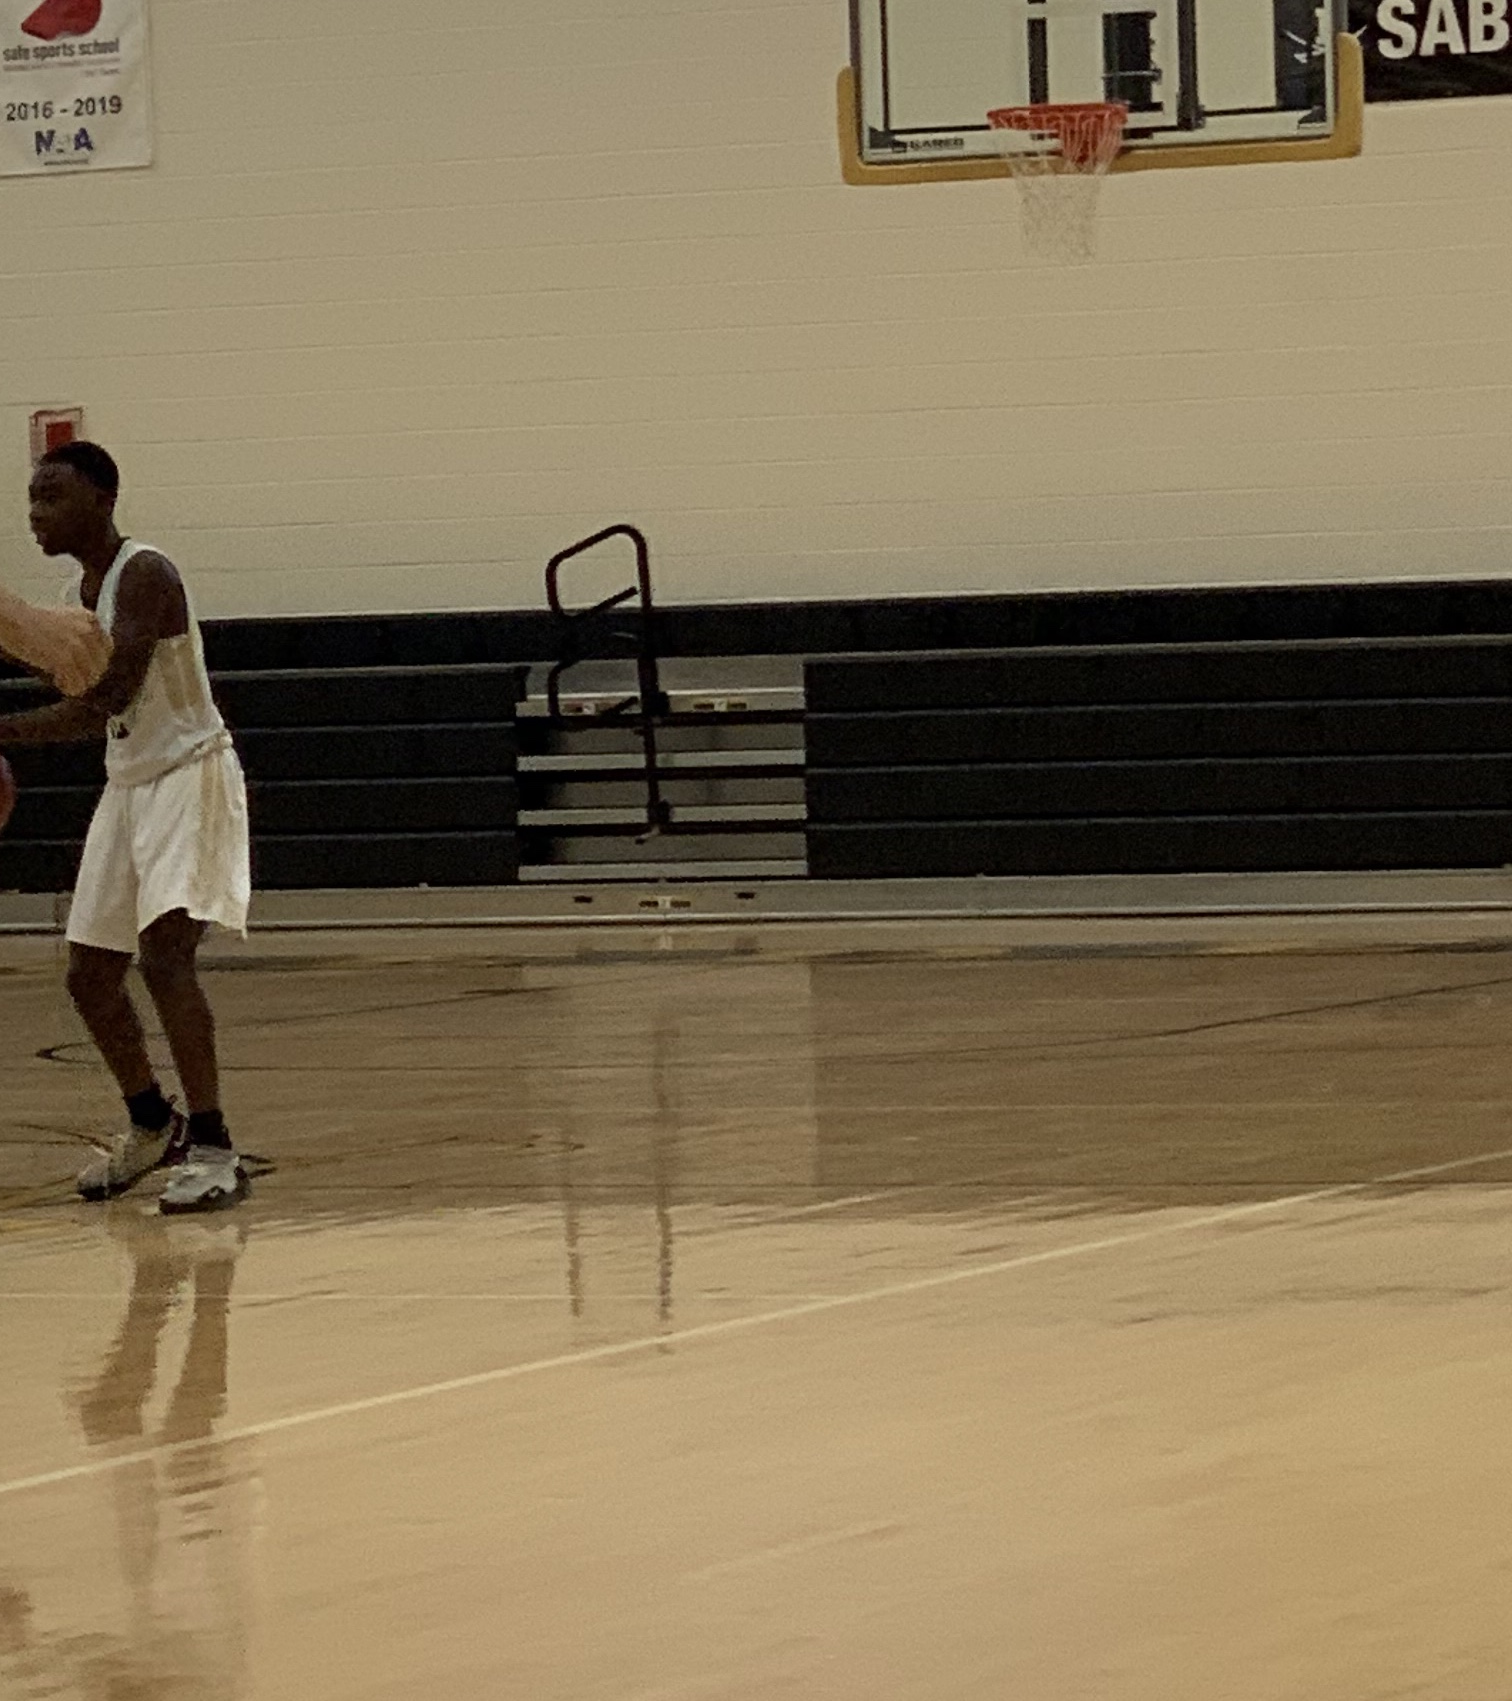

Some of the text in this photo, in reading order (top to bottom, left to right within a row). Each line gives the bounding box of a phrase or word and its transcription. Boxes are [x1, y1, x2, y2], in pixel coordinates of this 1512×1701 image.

[1376, 0, 1510, 59] SAB
[32, 43, 75, 61] sports
[78, 37, 120, 56] school
[5, 101, 53, 121] 2016
[73, 95, 122, 117] 2019
